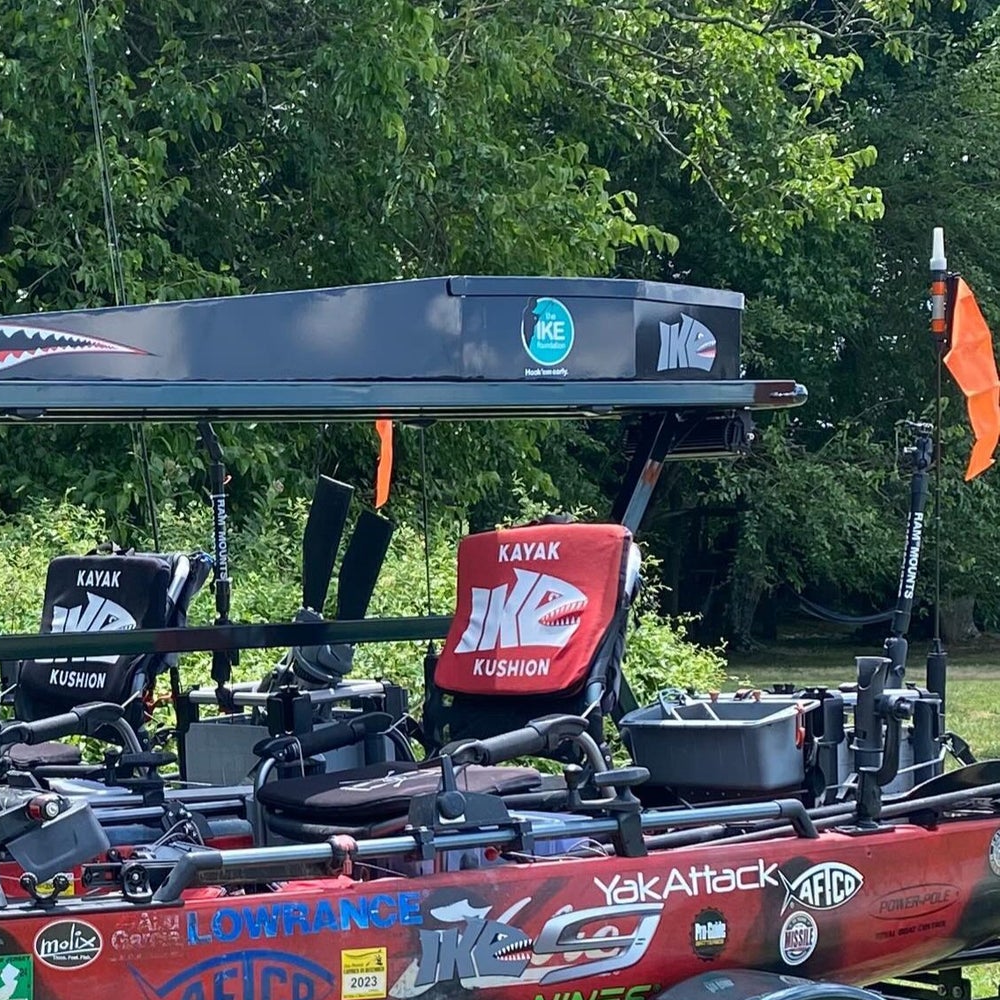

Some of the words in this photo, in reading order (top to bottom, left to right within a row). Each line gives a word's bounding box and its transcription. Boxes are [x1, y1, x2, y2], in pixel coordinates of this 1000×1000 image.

[536, 320, 566, 341] IKE
[657, 311, 717, 372] IKE
[217, 499, 226, 526] RAM
[911, 511, 924, 541] RAM
[218, 530, 229, 580] MOUNTS
[499, 541, 561, 563] KAYAK
[76, 569, 121, 588] KAYAK
[904, 545, 920, 600] MOUNTS
[454, 567, 588, 654] IKE
[49, 668, 107, 689] KUSHION
[473, 658, 550, 677] KUSHION
[594, 858, 779, 905] YakAttack
[799, 864, 856, 906] AFTCO
[879, 889, 951, 915] POWER-POLE
[186, 891, 424, 946] LOWRANCE
[41, 923, 97, 957] molix
[415, 916, 533, 988] IKE
[784, 927, 813, 949] MISSILE
[350, 975, 378, 989] 2023
